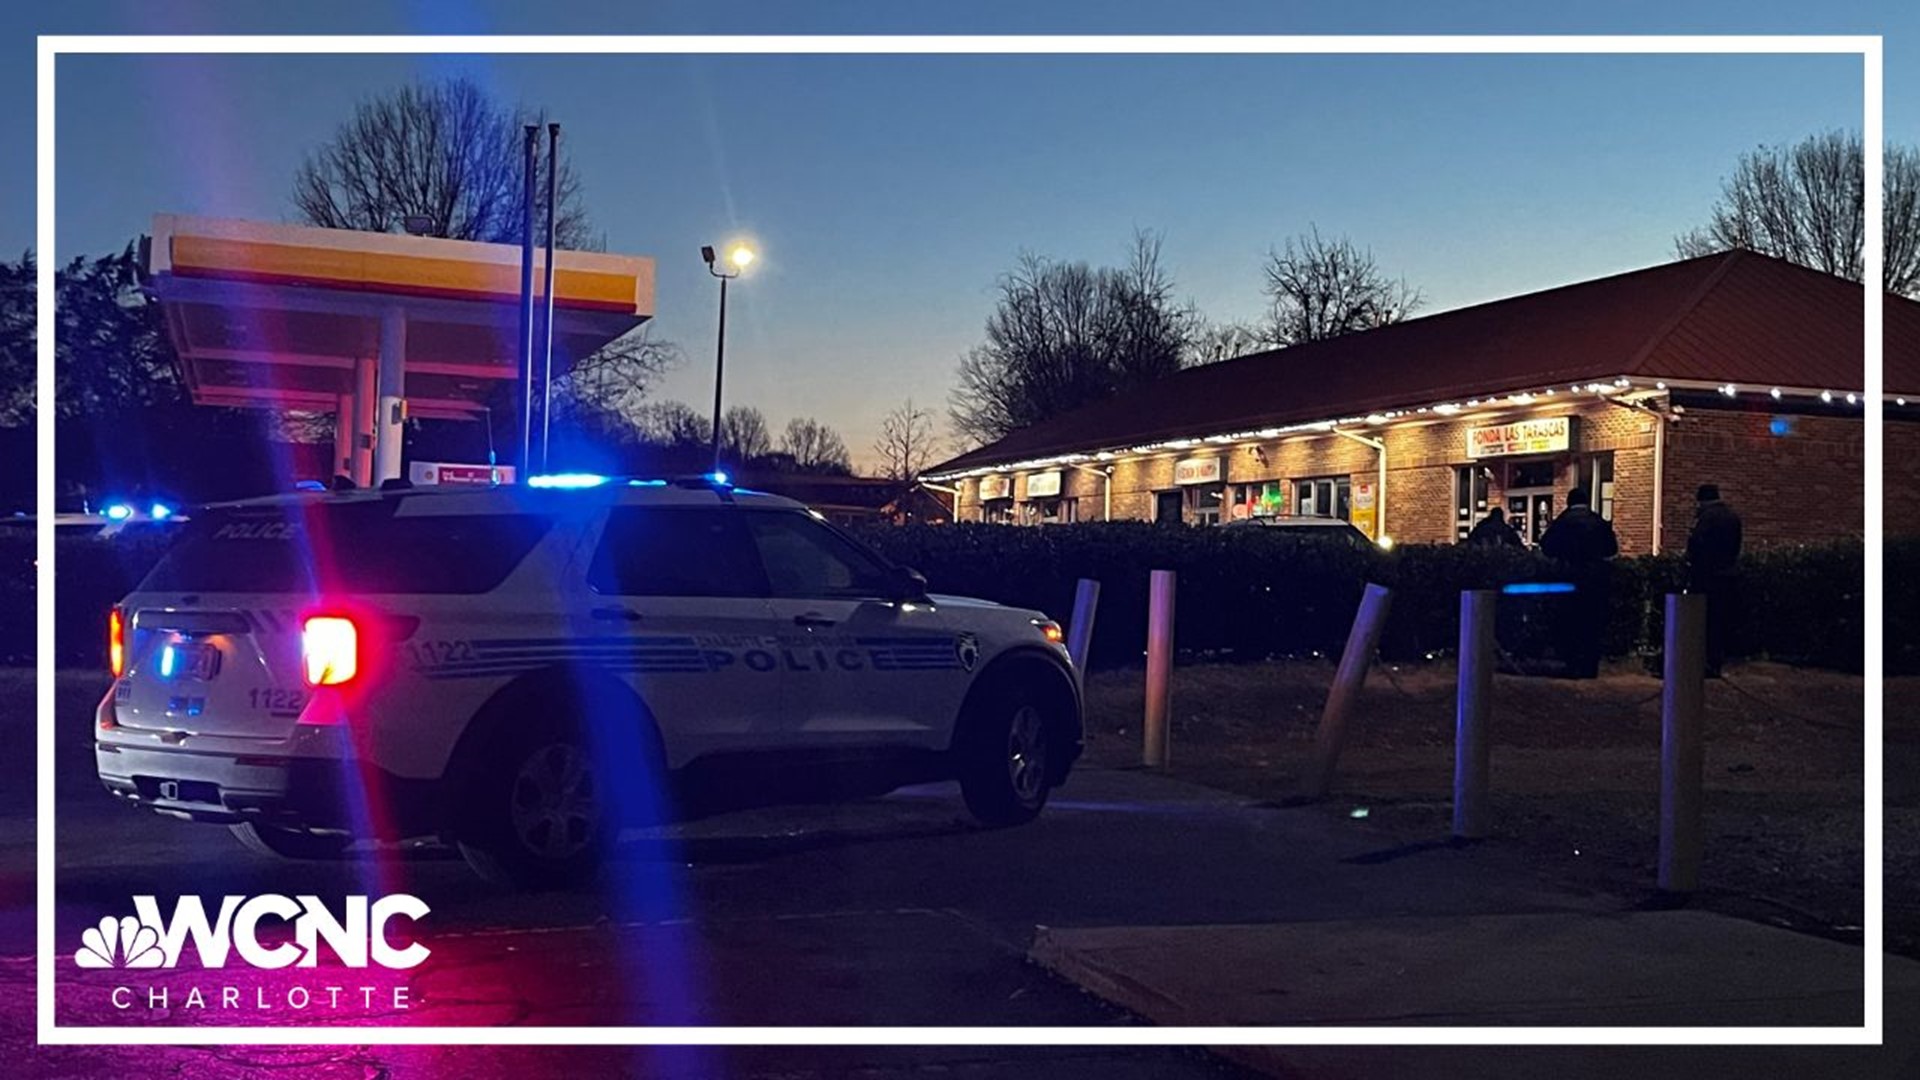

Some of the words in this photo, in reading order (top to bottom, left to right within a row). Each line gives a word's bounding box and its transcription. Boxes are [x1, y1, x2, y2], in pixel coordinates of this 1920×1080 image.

[1505, 425, 1520, 441] LAS
[212, 521, 296, 540] POLICE
[406, 640, 476, 664] 1122
[704, 649, 896, 672] POLICE
[249, 687, 303, 709] 1122
